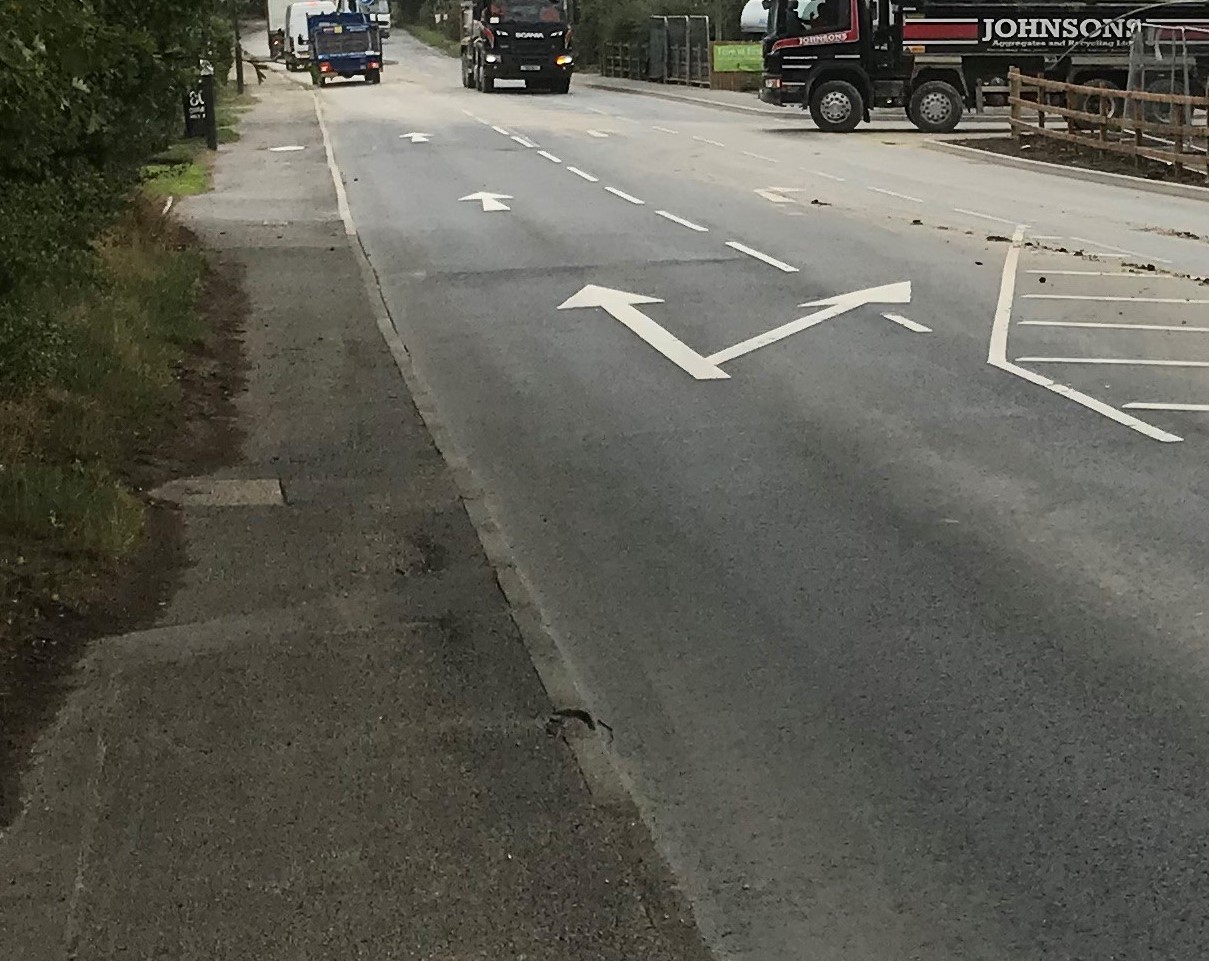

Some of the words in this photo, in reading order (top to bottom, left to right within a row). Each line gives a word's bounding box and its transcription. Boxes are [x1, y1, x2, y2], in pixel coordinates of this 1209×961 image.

[982, 18, 1141, 41] JOHNSONS
[798, 32, 848, 45] JOHNSONS
[992, 39, 1047, 47] Aggregates
[1048, 39, 1066, 47] and
[1068, 39, 1114, 48] Recycling
